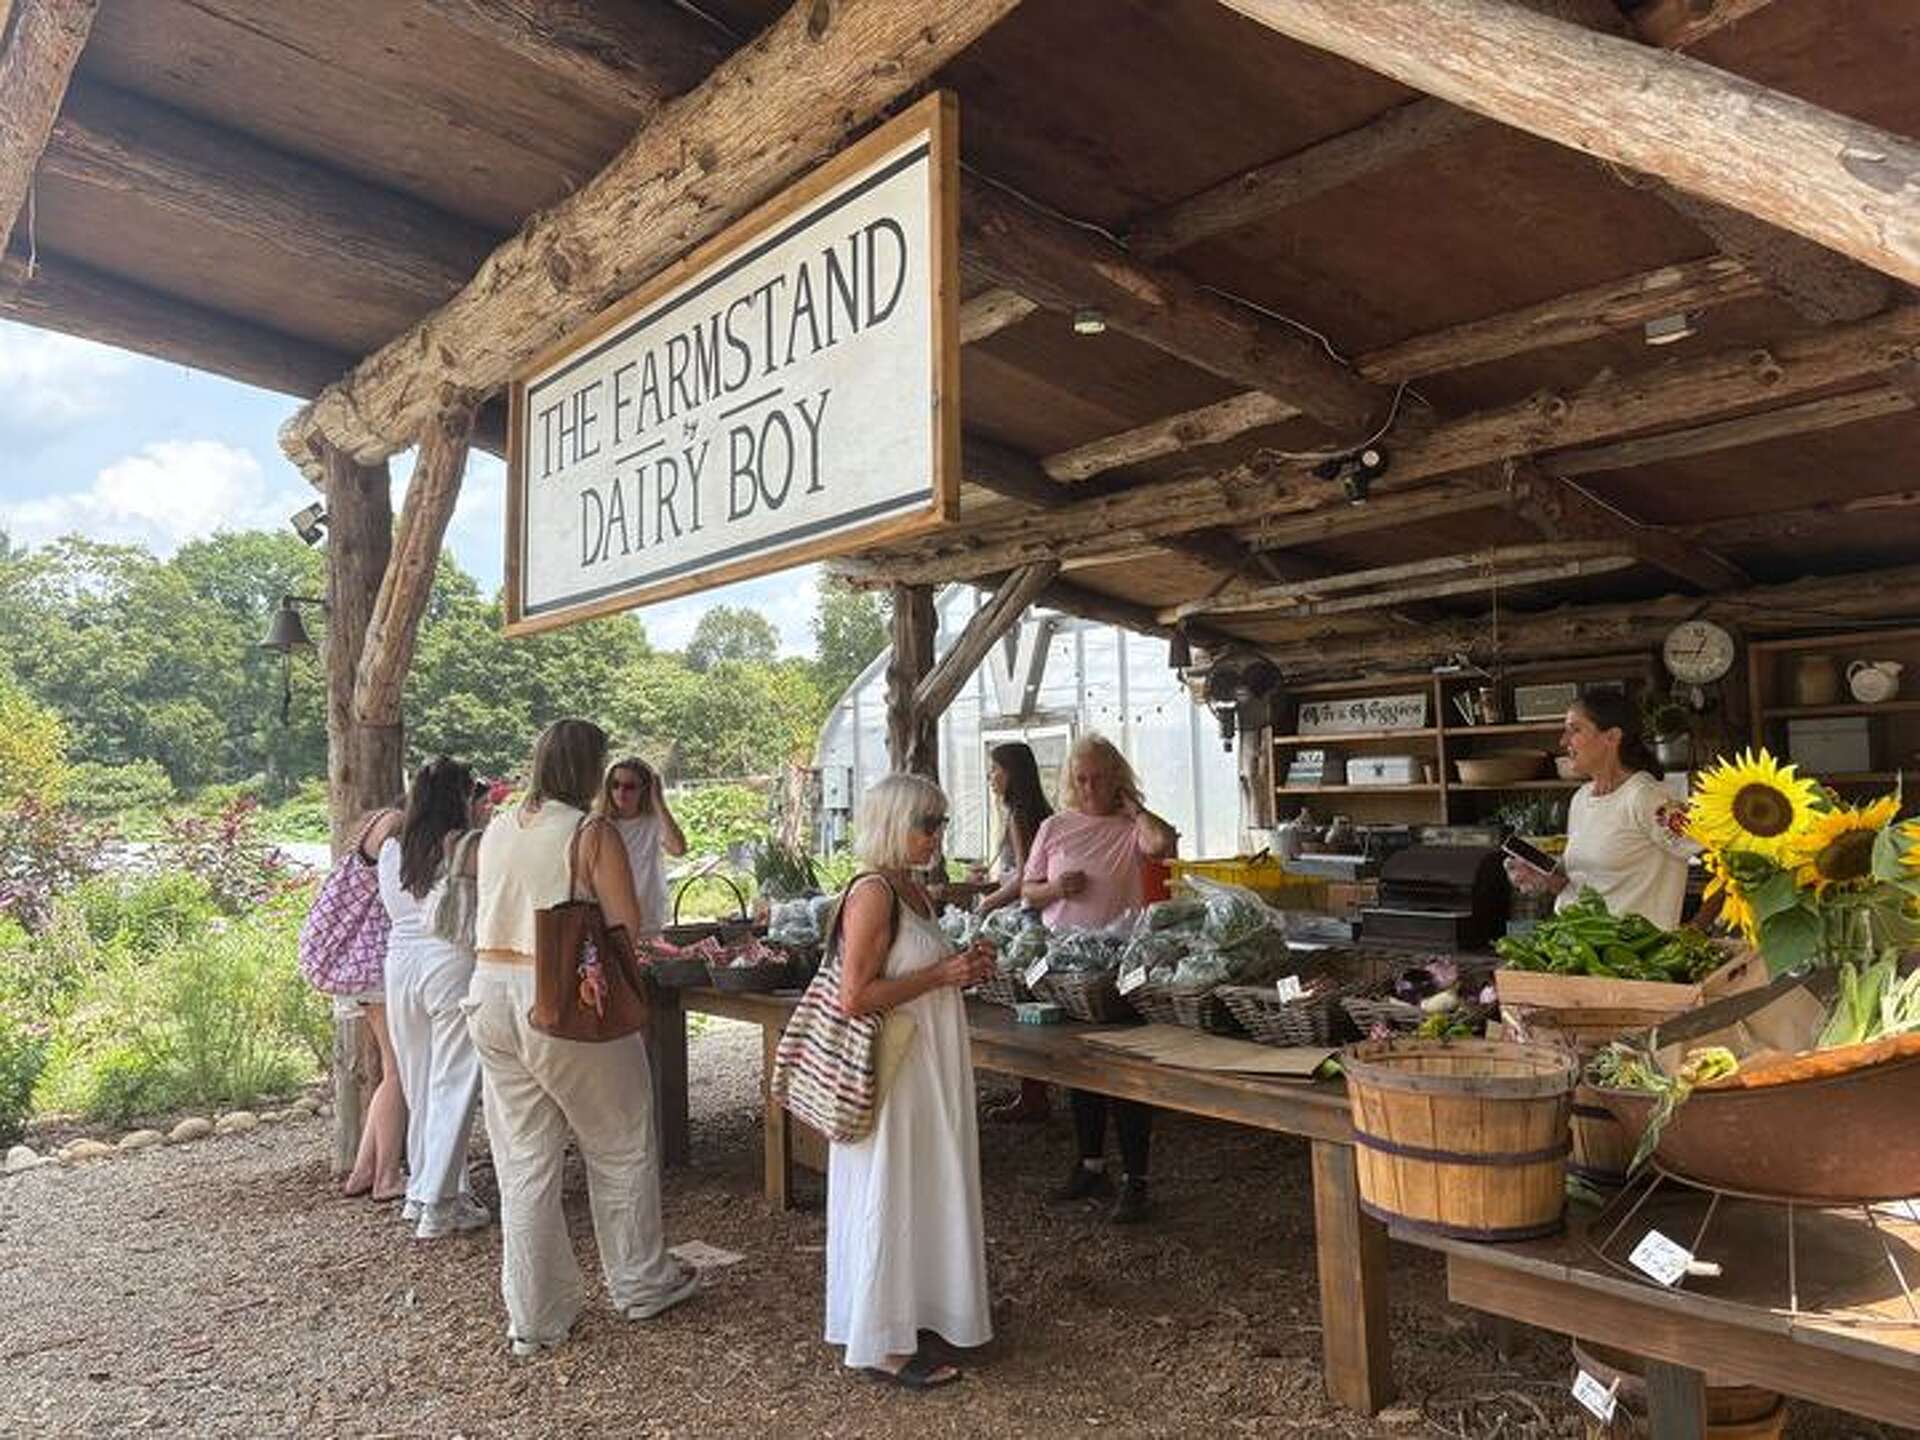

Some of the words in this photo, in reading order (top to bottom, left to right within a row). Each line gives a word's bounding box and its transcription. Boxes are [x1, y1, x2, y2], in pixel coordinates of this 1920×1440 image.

[539, 381, 601, 478] THE
[613, 217, 908, 444] FARMSTAND
[581, 442, 710, 567] DAIRY
[727, 389, 831, 522] BOY
